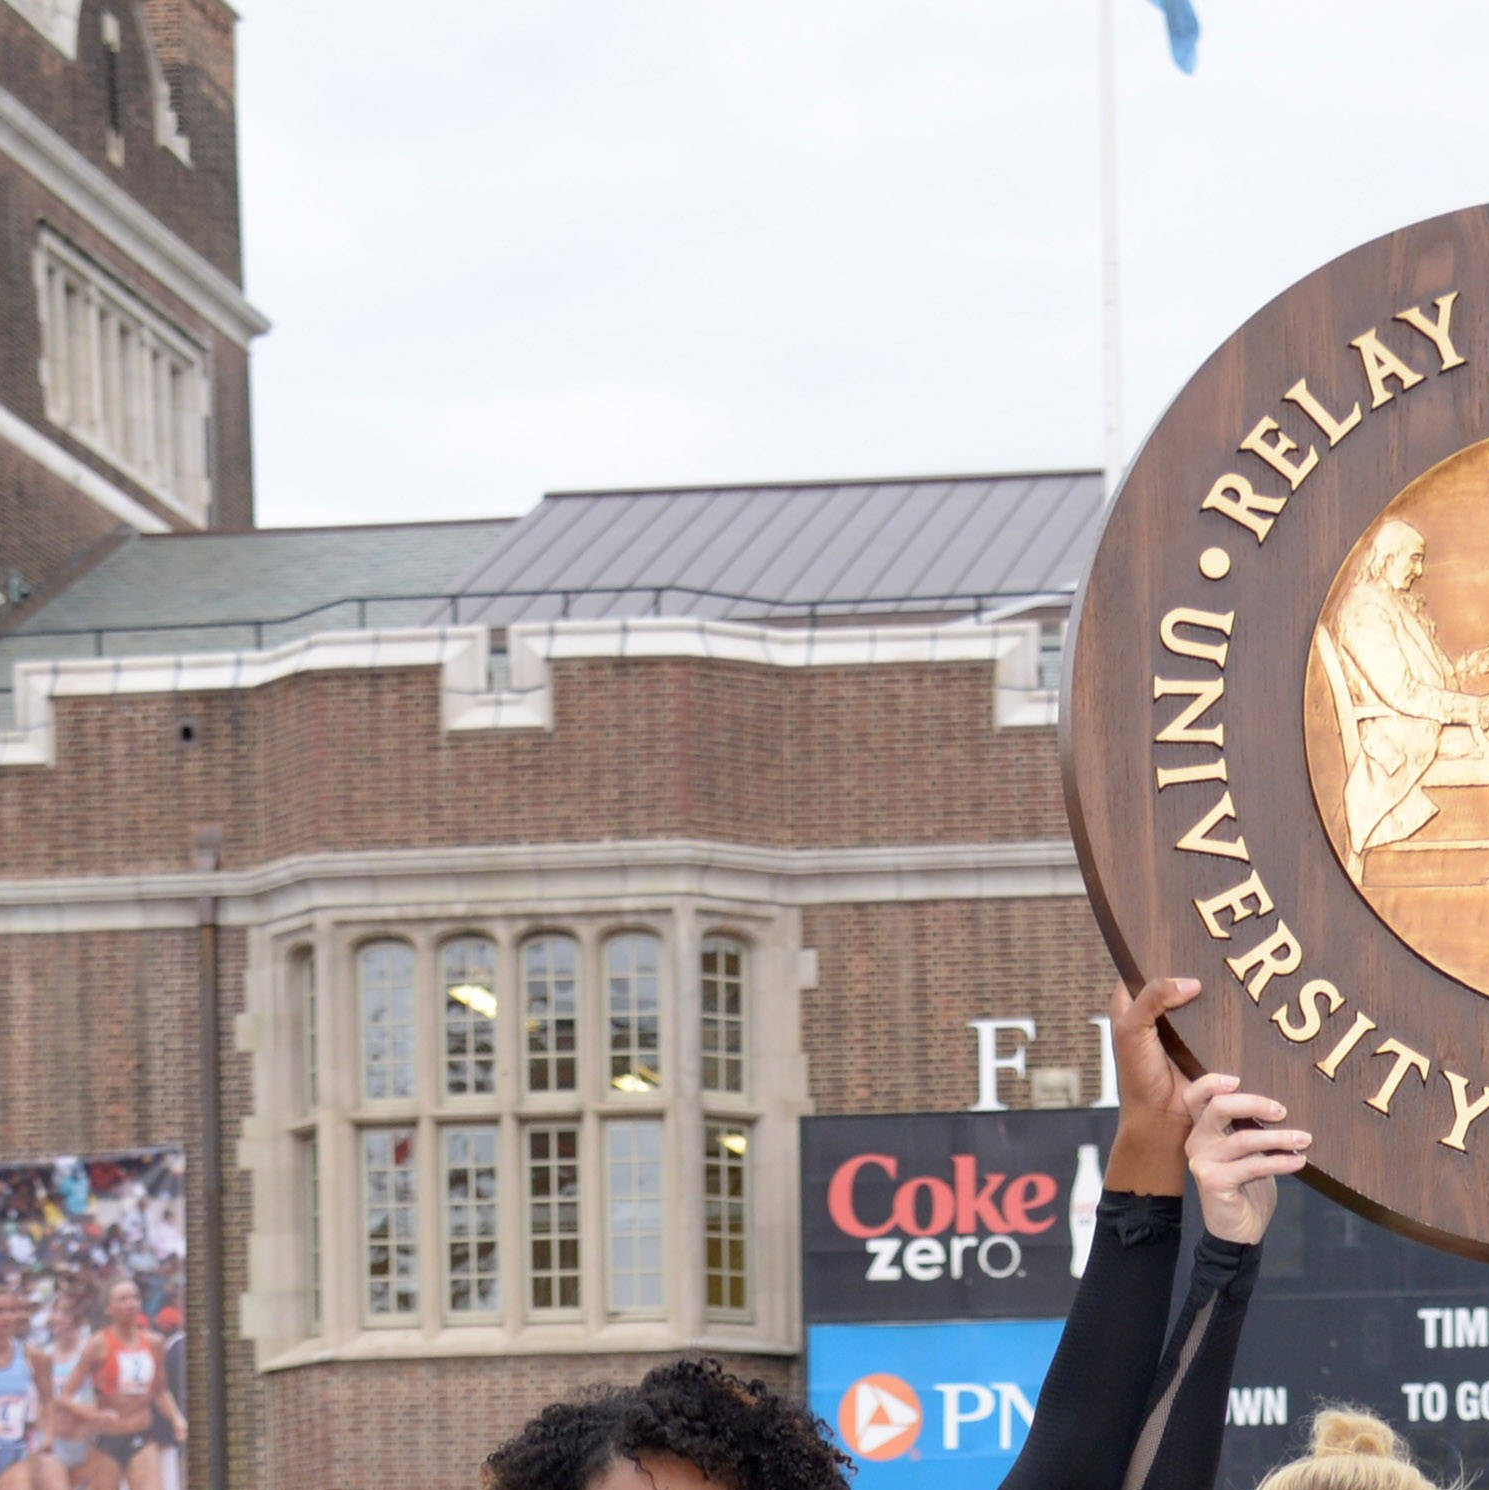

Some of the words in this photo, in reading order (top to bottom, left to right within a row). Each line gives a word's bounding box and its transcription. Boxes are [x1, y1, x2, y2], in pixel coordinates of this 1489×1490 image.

[1200, 290, 1467, 545] RELAY
[826, 1152, 1059, 1239] Coke
[864, 1234, 1024, 1282] zero
[932, 1382, 1036, 1451] PN
[1401, 1383, 1448, 1422] TO
